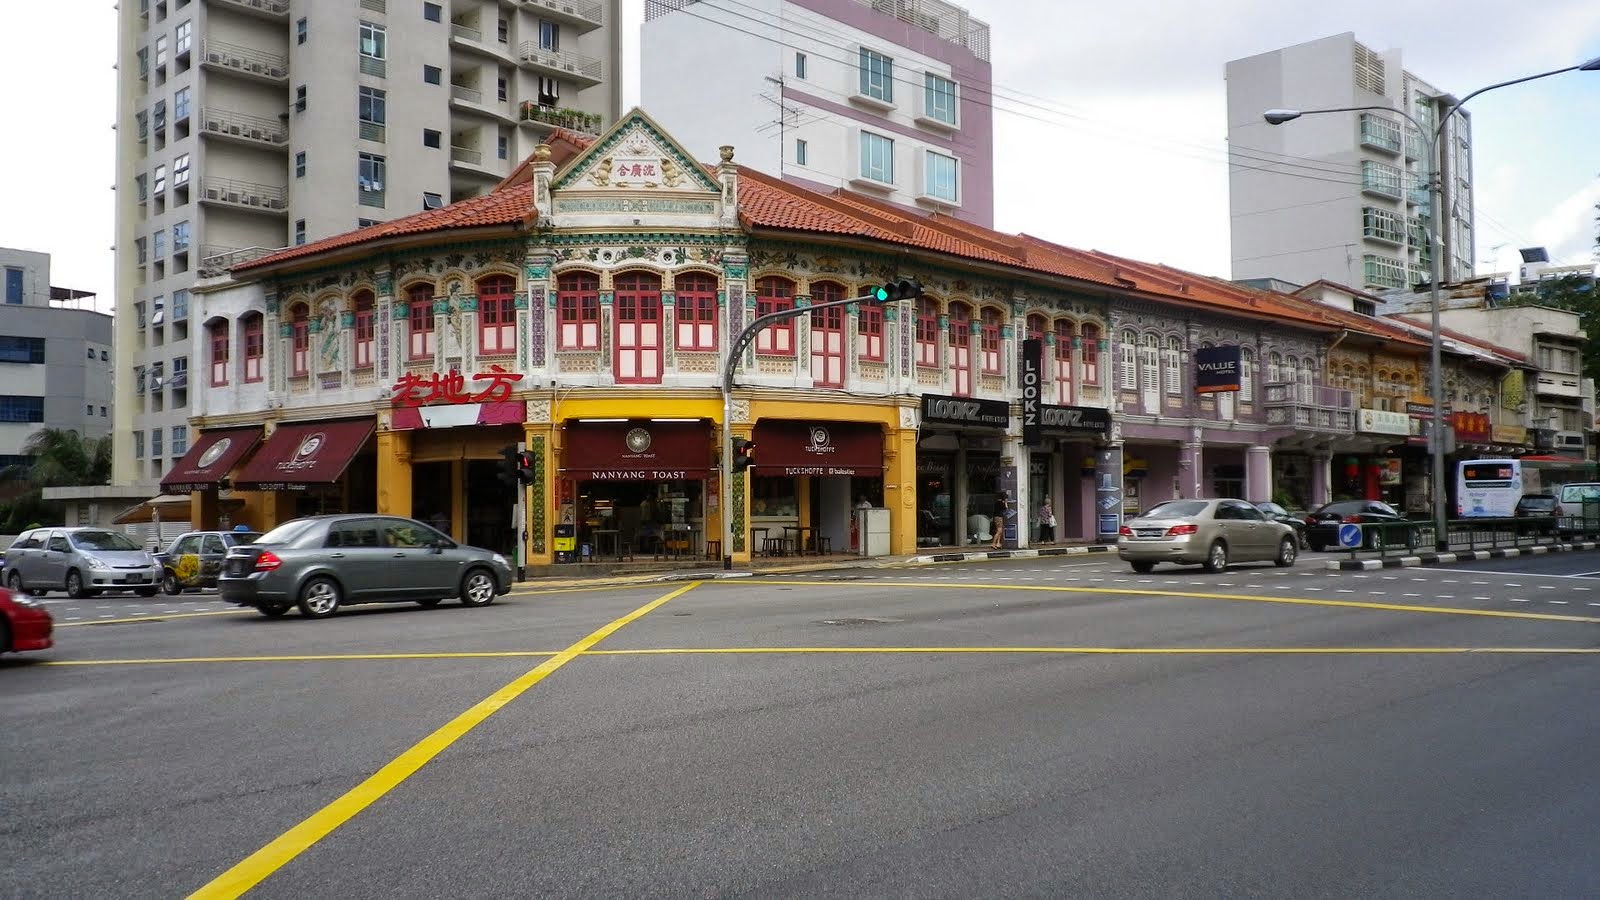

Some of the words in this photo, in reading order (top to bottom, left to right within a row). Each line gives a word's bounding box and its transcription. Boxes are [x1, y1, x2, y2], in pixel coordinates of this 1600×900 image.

[1198, 361, 1236, 371] VALUE
[391, 364, 524, 407] 老地方
[1024, 360, 1037, 426] LOOKZ
[928, 398, 981, 421] LOOKZ
[1041, 407, 1083, 427] LOOKZ
[592, 471, 646, 479] NANYANG
[652, 471, 685, 479] TOAST
